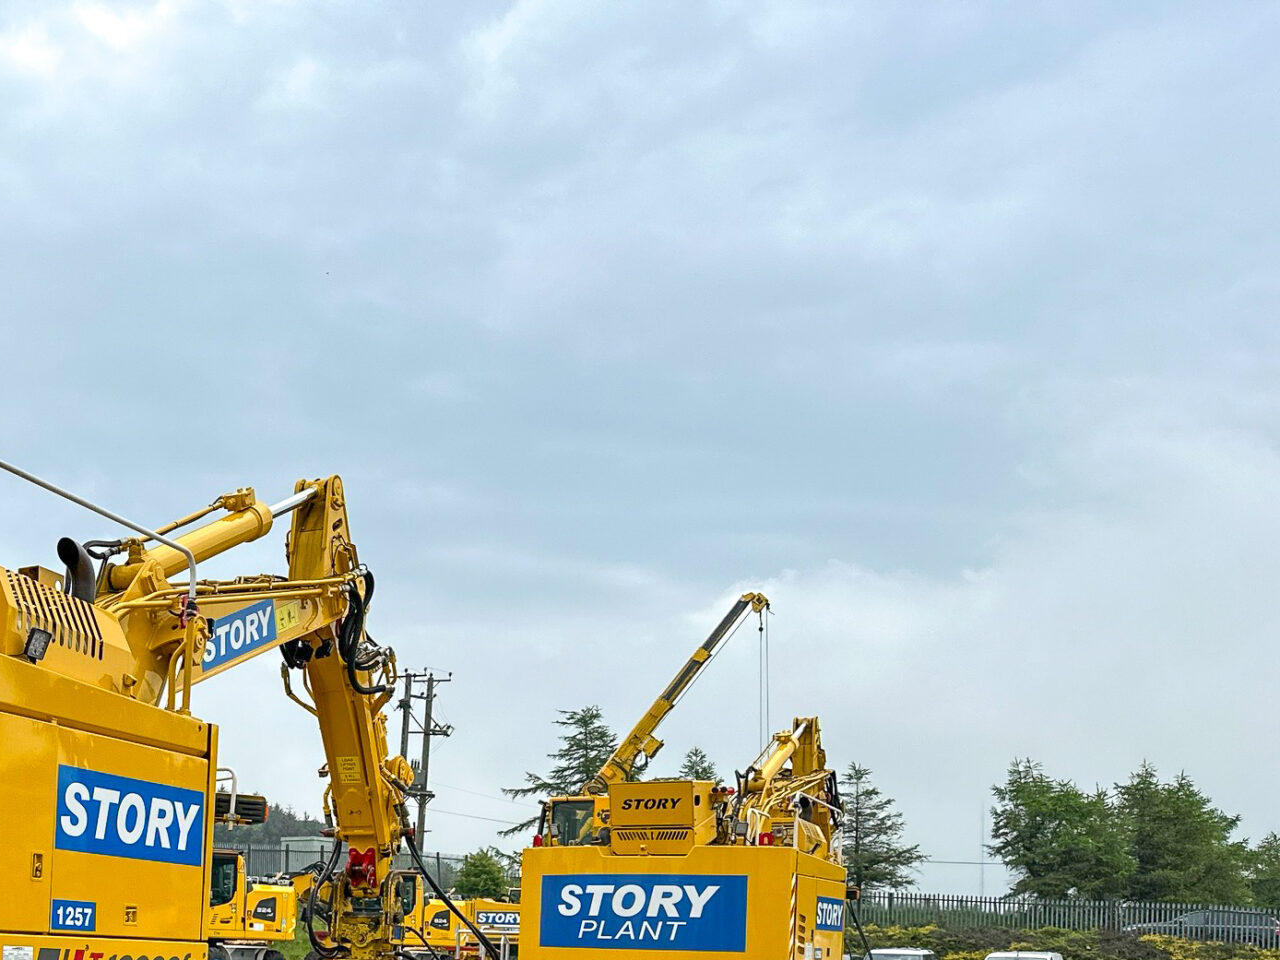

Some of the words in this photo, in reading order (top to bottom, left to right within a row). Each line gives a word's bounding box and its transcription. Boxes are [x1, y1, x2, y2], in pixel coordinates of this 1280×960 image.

[203, 606, 272, 664] STORY
[621, 798, 682, 810] STORY
[60, 782, 200, 851] STORY
[558, 884, 720, 918] STORY
[56, 905, 92, 926] 1257
[477, 912, 520, 924] STORY
[816, 902, 844, 927] STORY
[578, 919, 687, 941] PLANT
